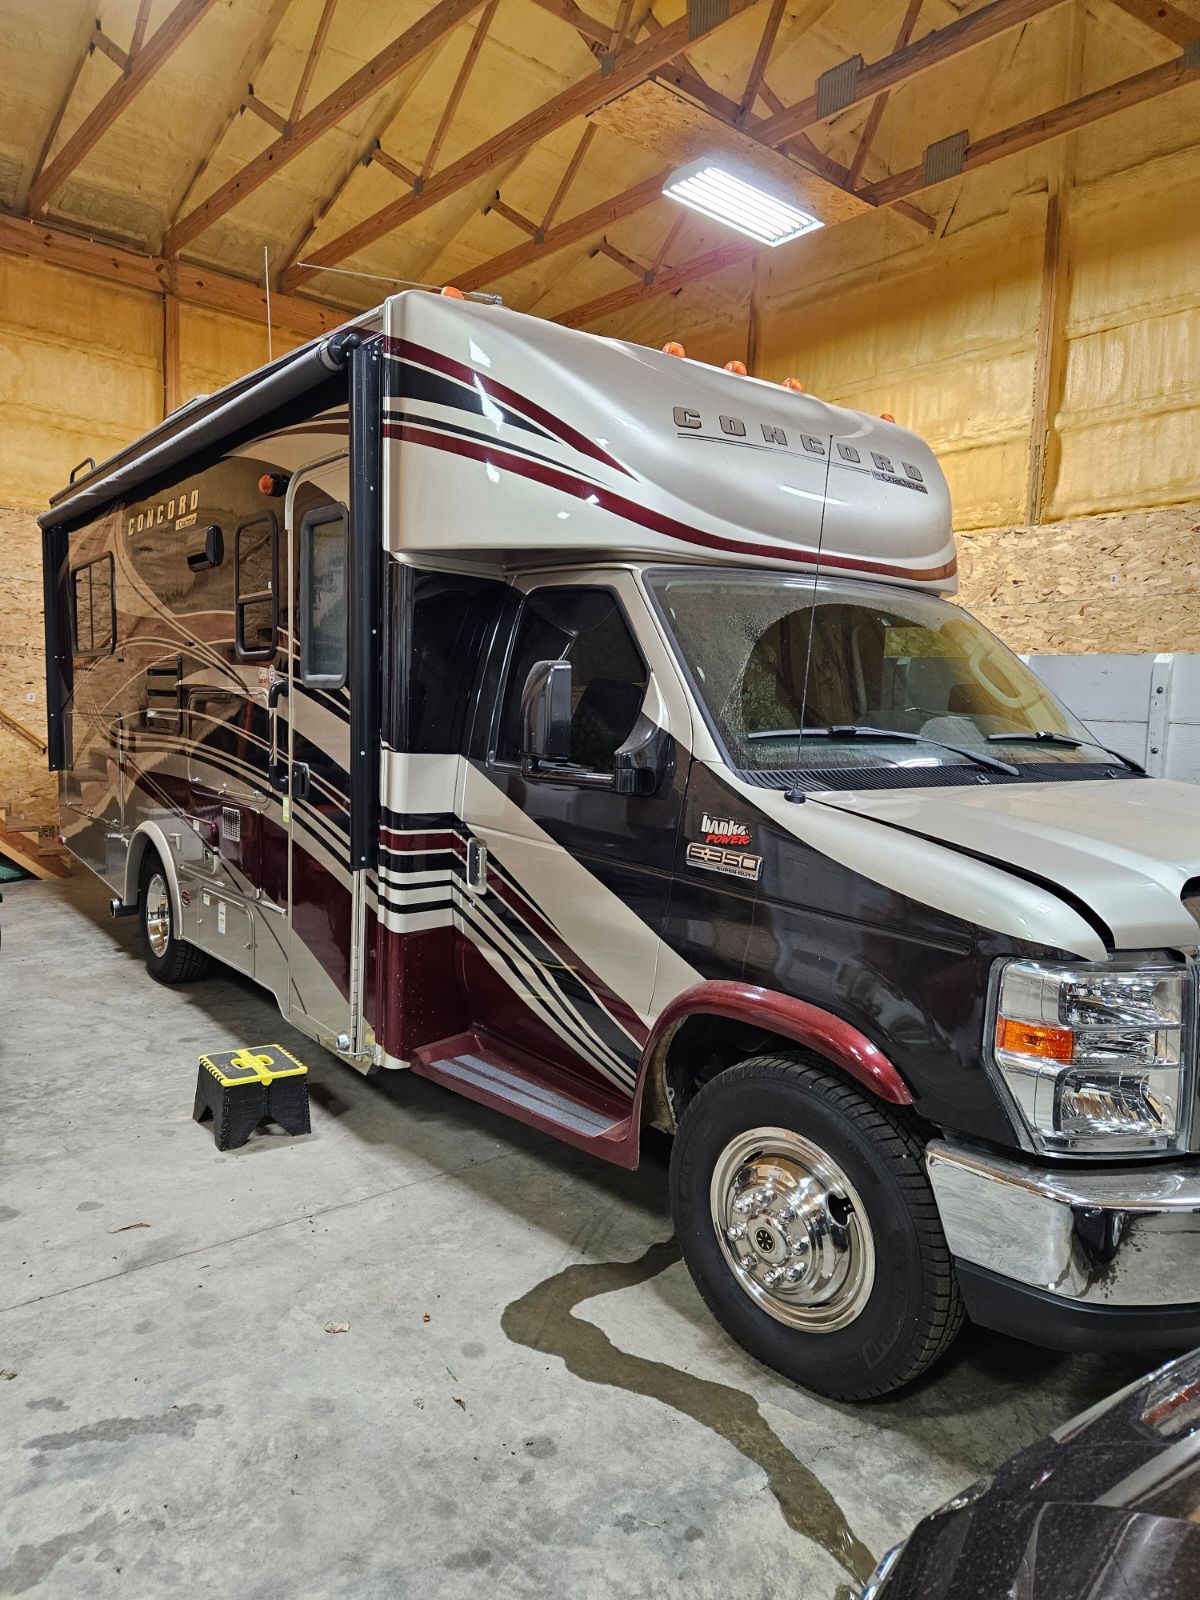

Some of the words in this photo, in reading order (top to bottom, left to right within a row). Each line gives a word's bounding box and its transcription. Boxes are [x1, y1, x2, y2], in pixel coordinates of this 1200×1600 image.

[673, 406, 924, 482] CONCORD
[128, 489, 199, 536] CONCORD
[705, 834, 750, 845] POWER
[716, 865, 737, 875] SUPER
